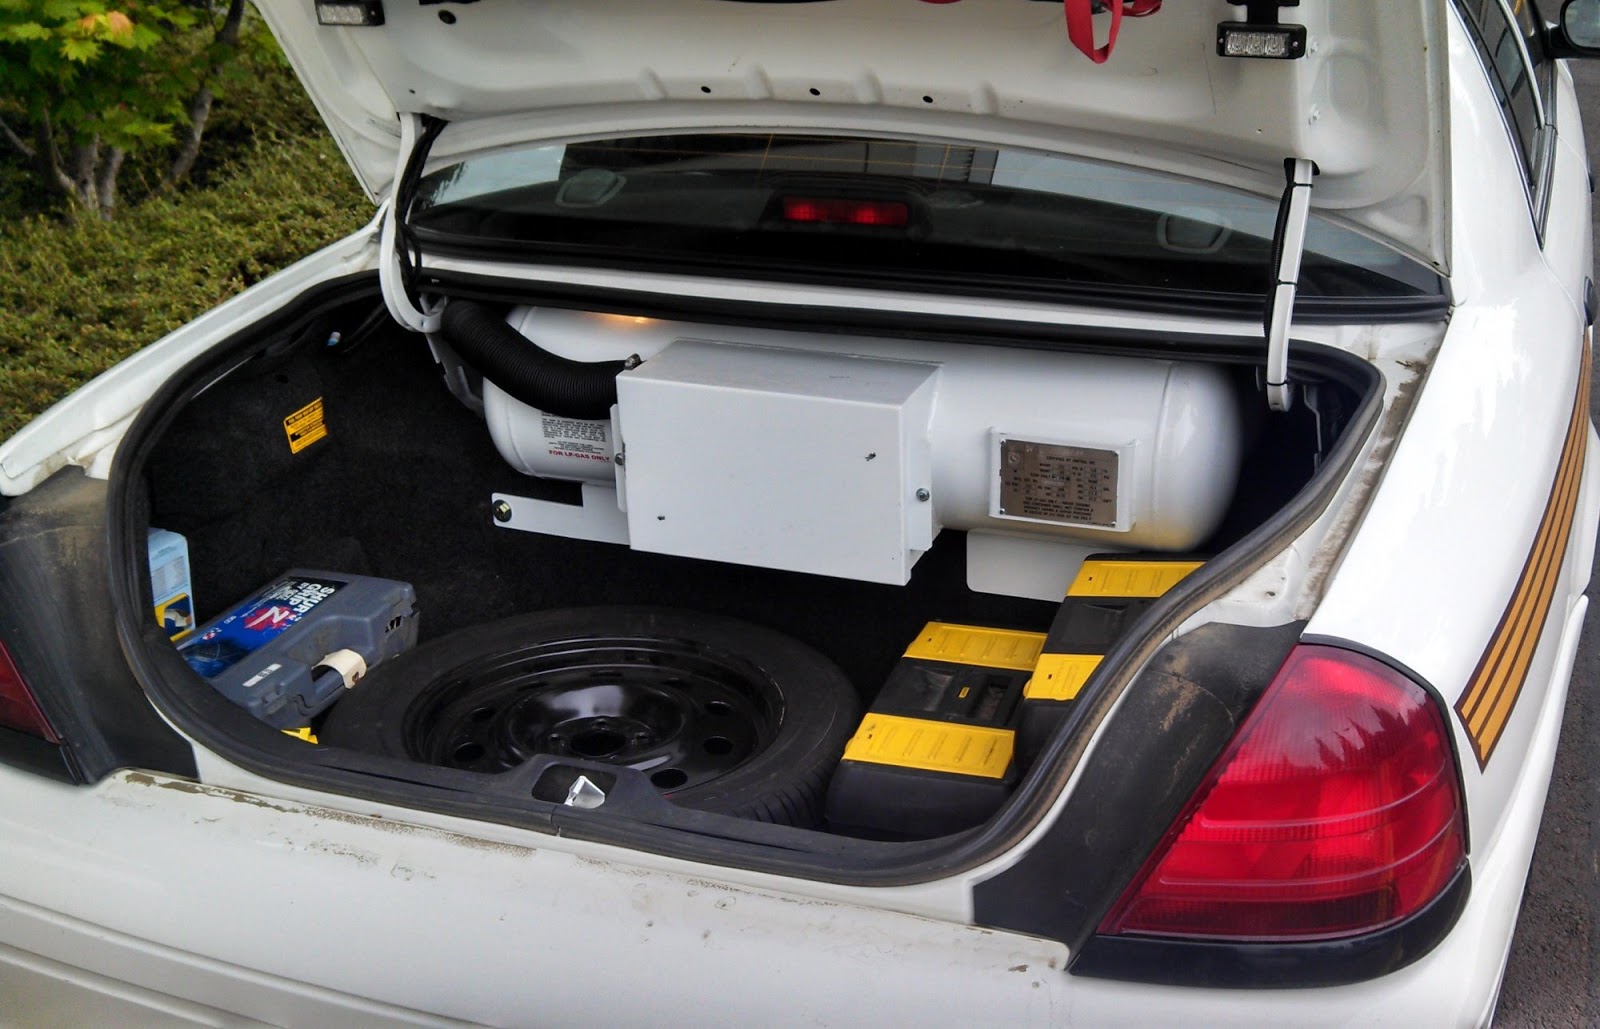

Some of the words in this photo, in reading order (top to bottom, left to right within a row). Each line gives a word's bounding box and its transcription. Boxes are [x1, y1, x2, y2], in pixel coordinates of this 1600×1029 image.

[565, 451, 590, 459] LP-GAS
[289, 583, 322, 606] GRIP
[293, 586, 336, 613] SHUR
